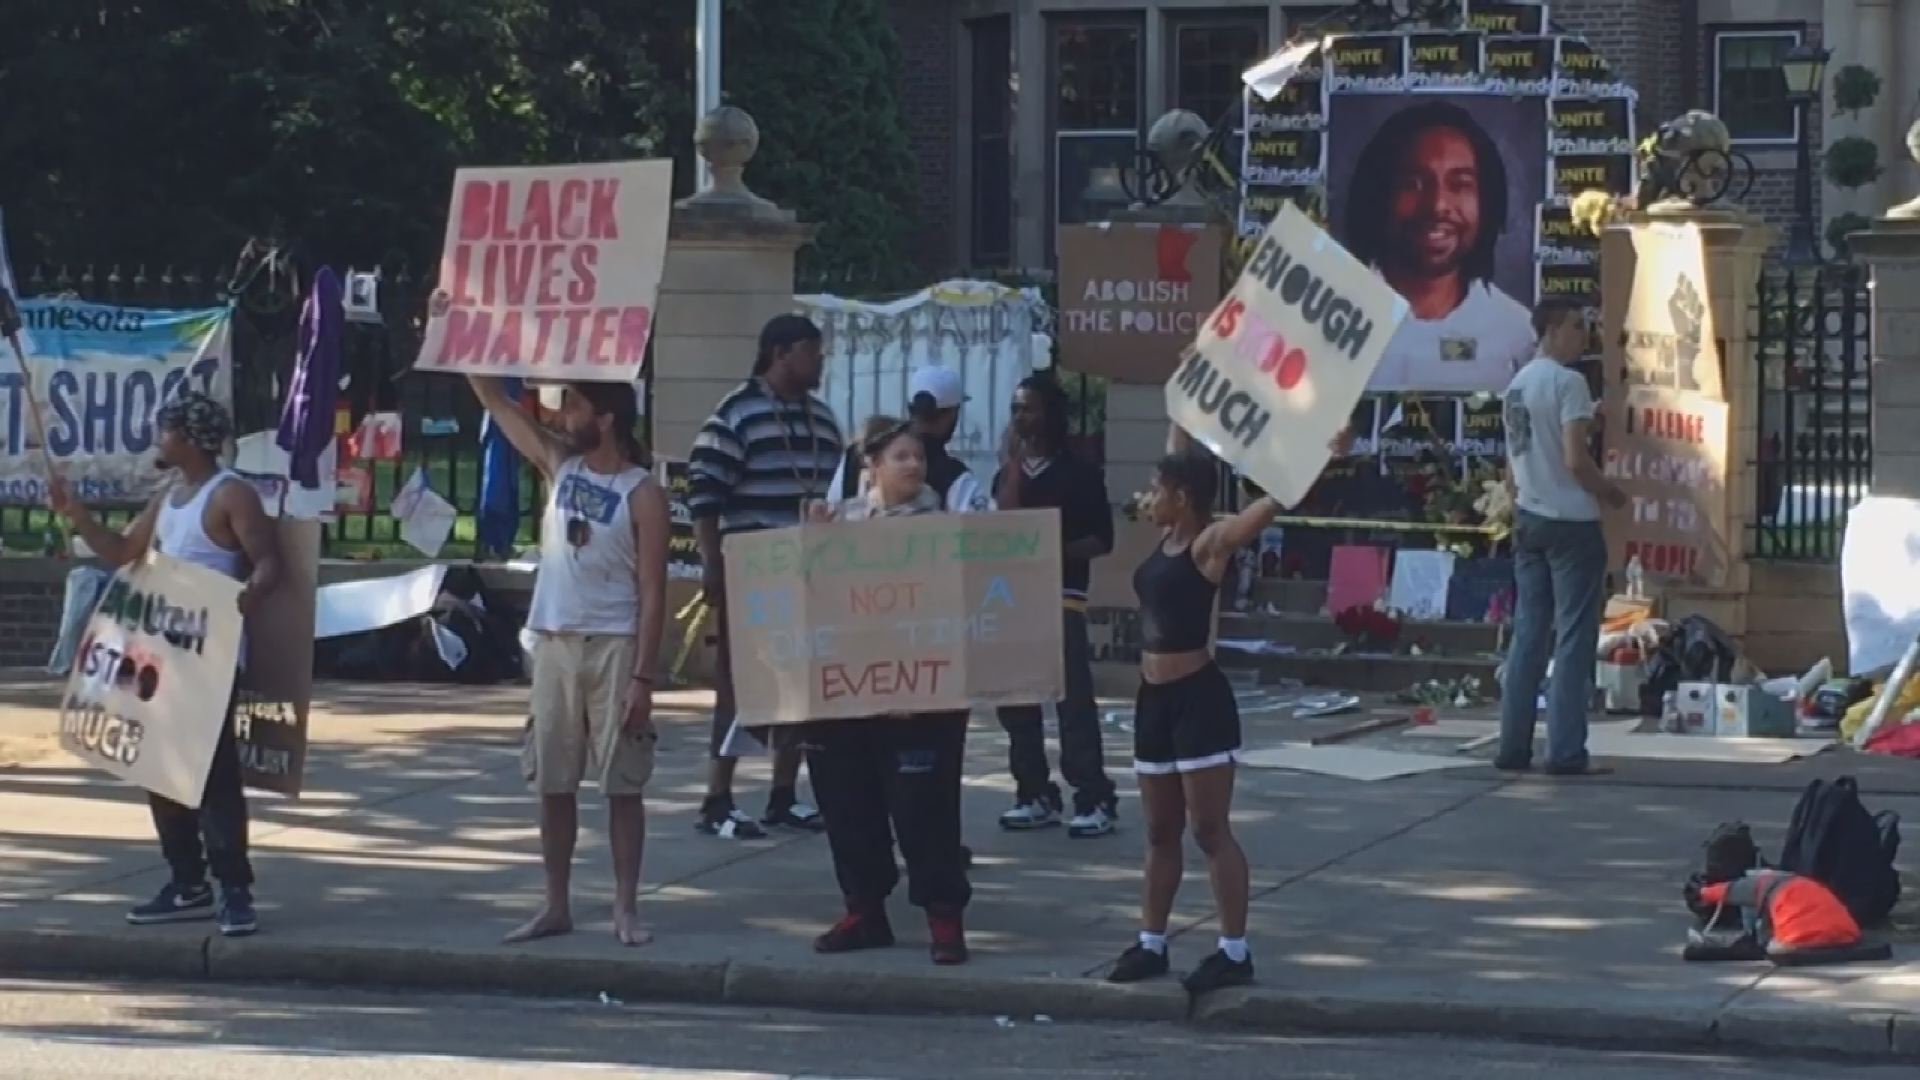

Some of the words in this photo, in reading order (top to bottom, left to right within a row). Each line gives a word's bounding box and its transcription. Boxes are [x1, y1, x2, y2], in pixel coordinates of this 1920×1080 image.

[458, 177, 621, 241] BLACK
[449, 244, 599, 307] LIVES
[1083, 280, 1189, 302] ABOLISH
[1247, 234, 1374, 361] ENOUGH
[437, 306, 650, 366] MATTER
[1065, 310, 1113, 332] THE
[1211, 295, 1246, 342] IS
[1175, 350, 1271, 449] MUCH
[743, 528, 1042, 581] REVOLUTION
[850, 582, 925, 615] NOT
[982, 575, 1015, 608] A
[898, 610, 1002, 646] TIME
[821, 658, 953, 702] EVENT
